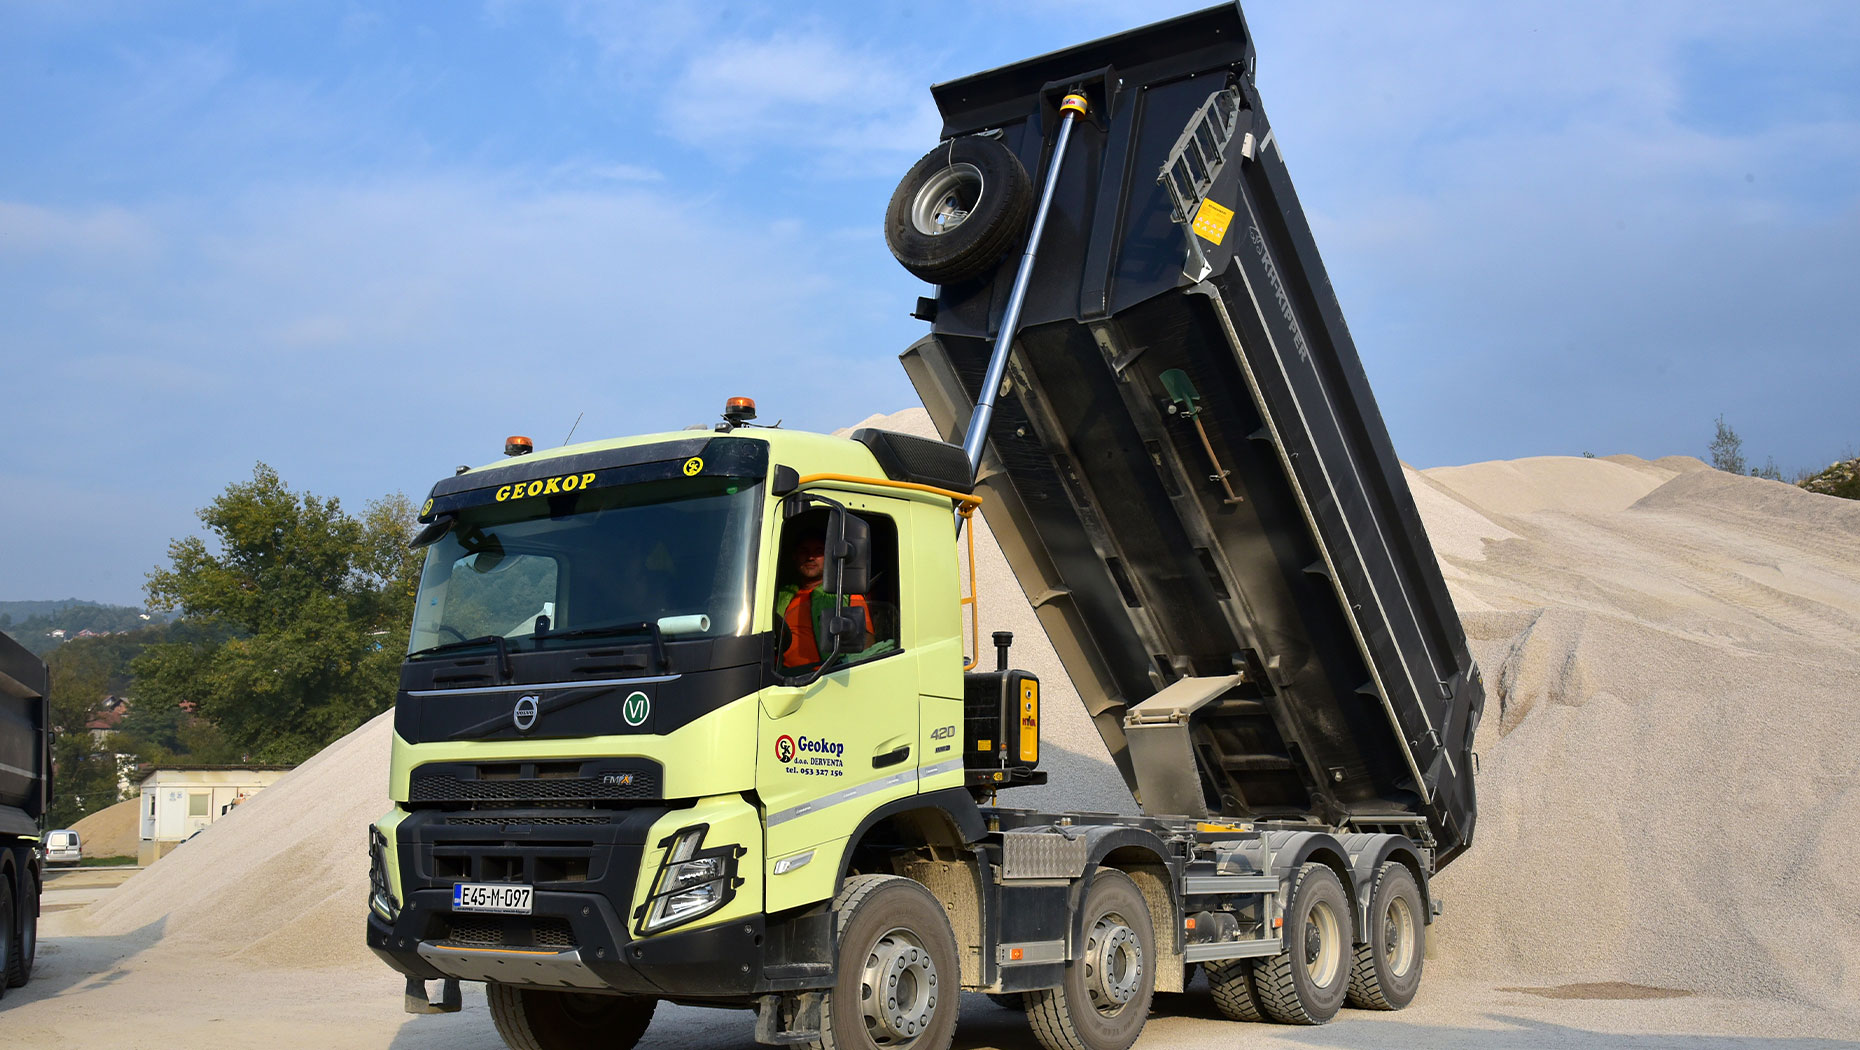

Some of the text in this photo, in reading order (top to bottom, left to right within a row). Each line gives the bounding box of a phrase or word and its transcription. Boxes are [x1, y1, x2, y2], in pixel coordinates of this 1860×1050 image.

[1261, 253, 1307, 362] KH-KIPPER
[495, 472, 596, 502] GEOKOP
[628, 700, 645, 719] VI
[930, 725, 956, 740] 420
[798, 735, 844, 757] Geokop
[786, 766, 843, 777] tel. 053 327 156
[794, 757, 843, 767] d.o.o. DERVENTA
[603, 774, 634, 785] FMX
[462, 887, 530, 907] E45-M-097
